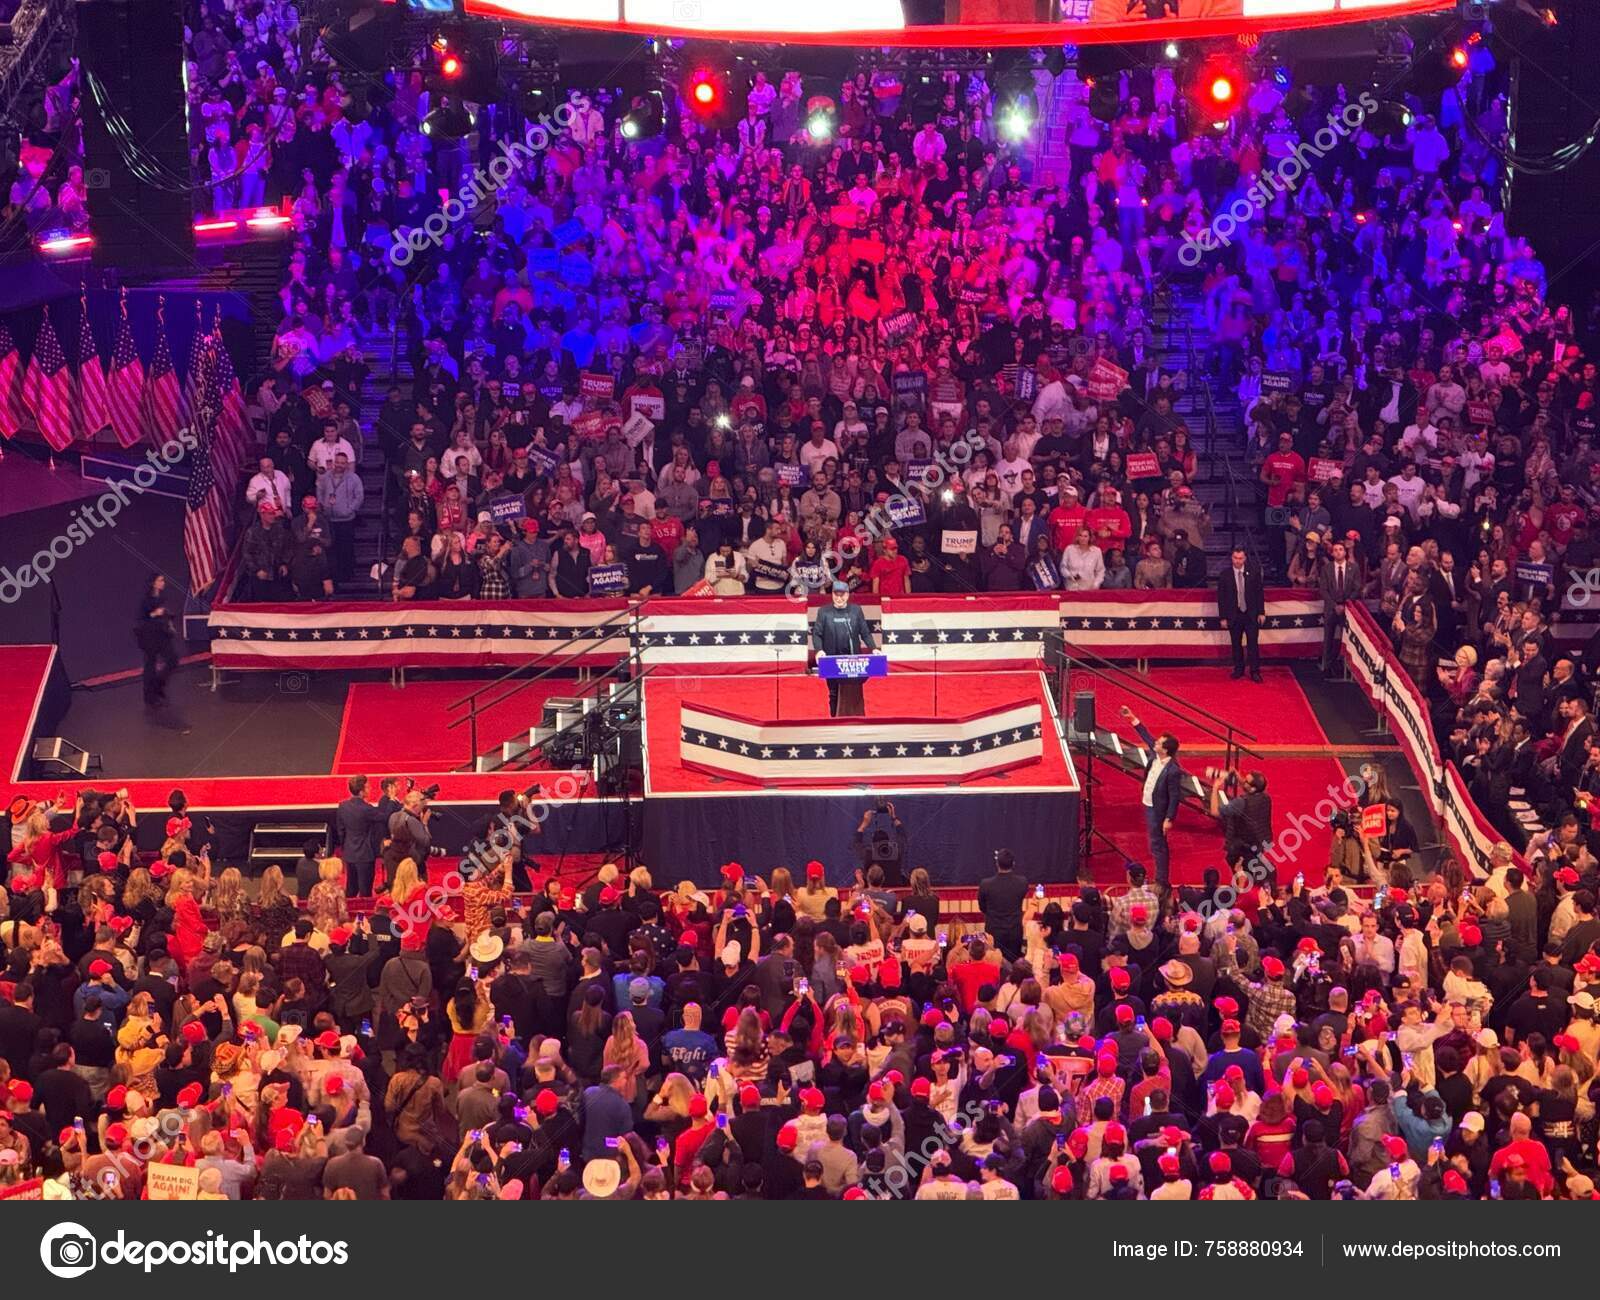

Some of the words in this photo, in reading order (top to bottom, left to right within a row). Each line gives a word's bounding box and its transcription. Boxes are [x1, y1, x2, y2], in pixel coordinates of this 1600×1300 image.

[582, 379, 612, 389] TRUMP
[945, 537, 975, 545] TRUMP
[593, 576, 622, 585] AGAIN!
[151, 1173, 177, 1184] DREAM
[152, 1182, 190, 1194] AGAIN!
